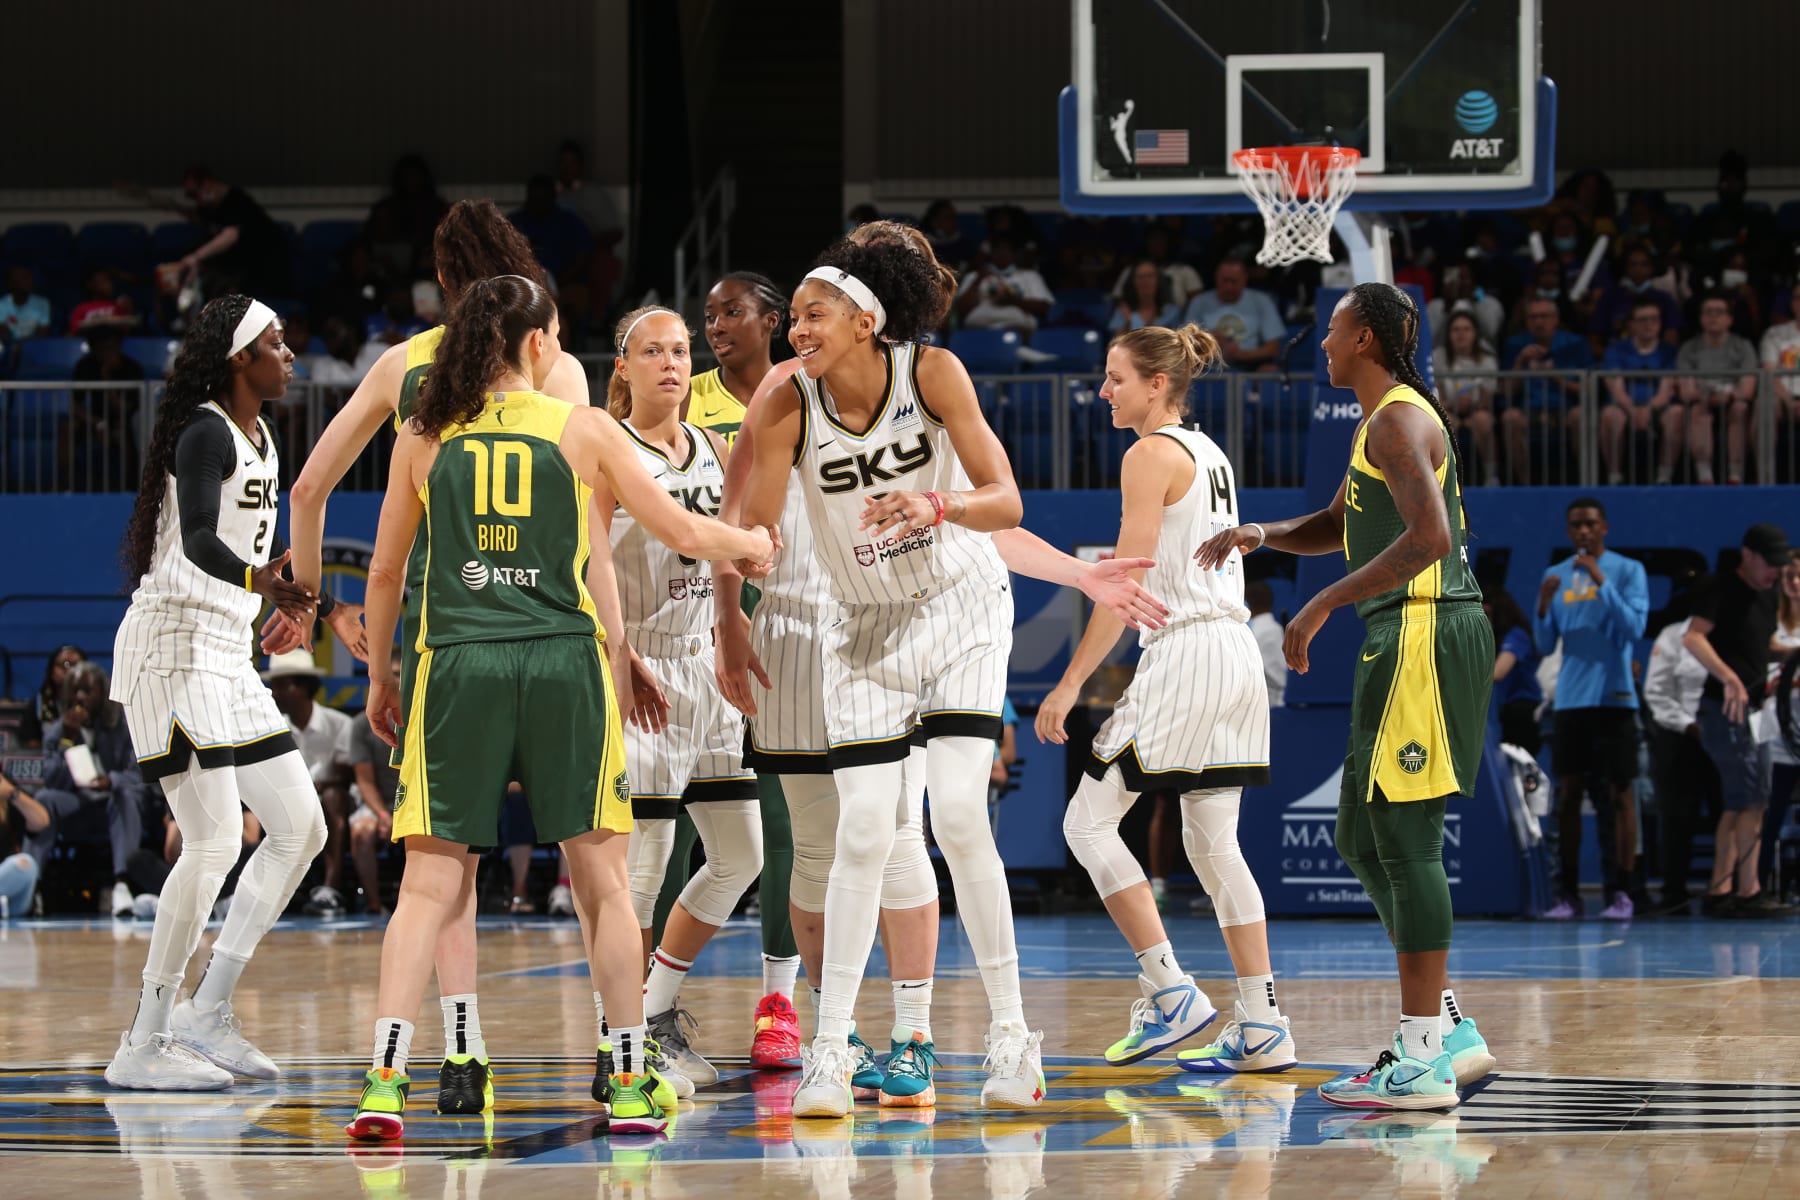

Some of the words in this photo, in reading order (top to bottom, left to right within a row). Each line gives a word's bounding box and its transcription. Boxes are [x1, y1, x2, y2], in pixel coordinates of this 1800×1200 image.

[1449, 138, 1504, 159] AT&T
[463, 439, 533, 517] 10
[817, 429, 934, 496] SKY
[1206, 464, 1233, 516] 14
[253, 519, 268, 555] 2
[477, 523, 518, 552] BIRD
[878, 535, 934, 563] Medicine
[493, 566, 541, 588] AT&T
